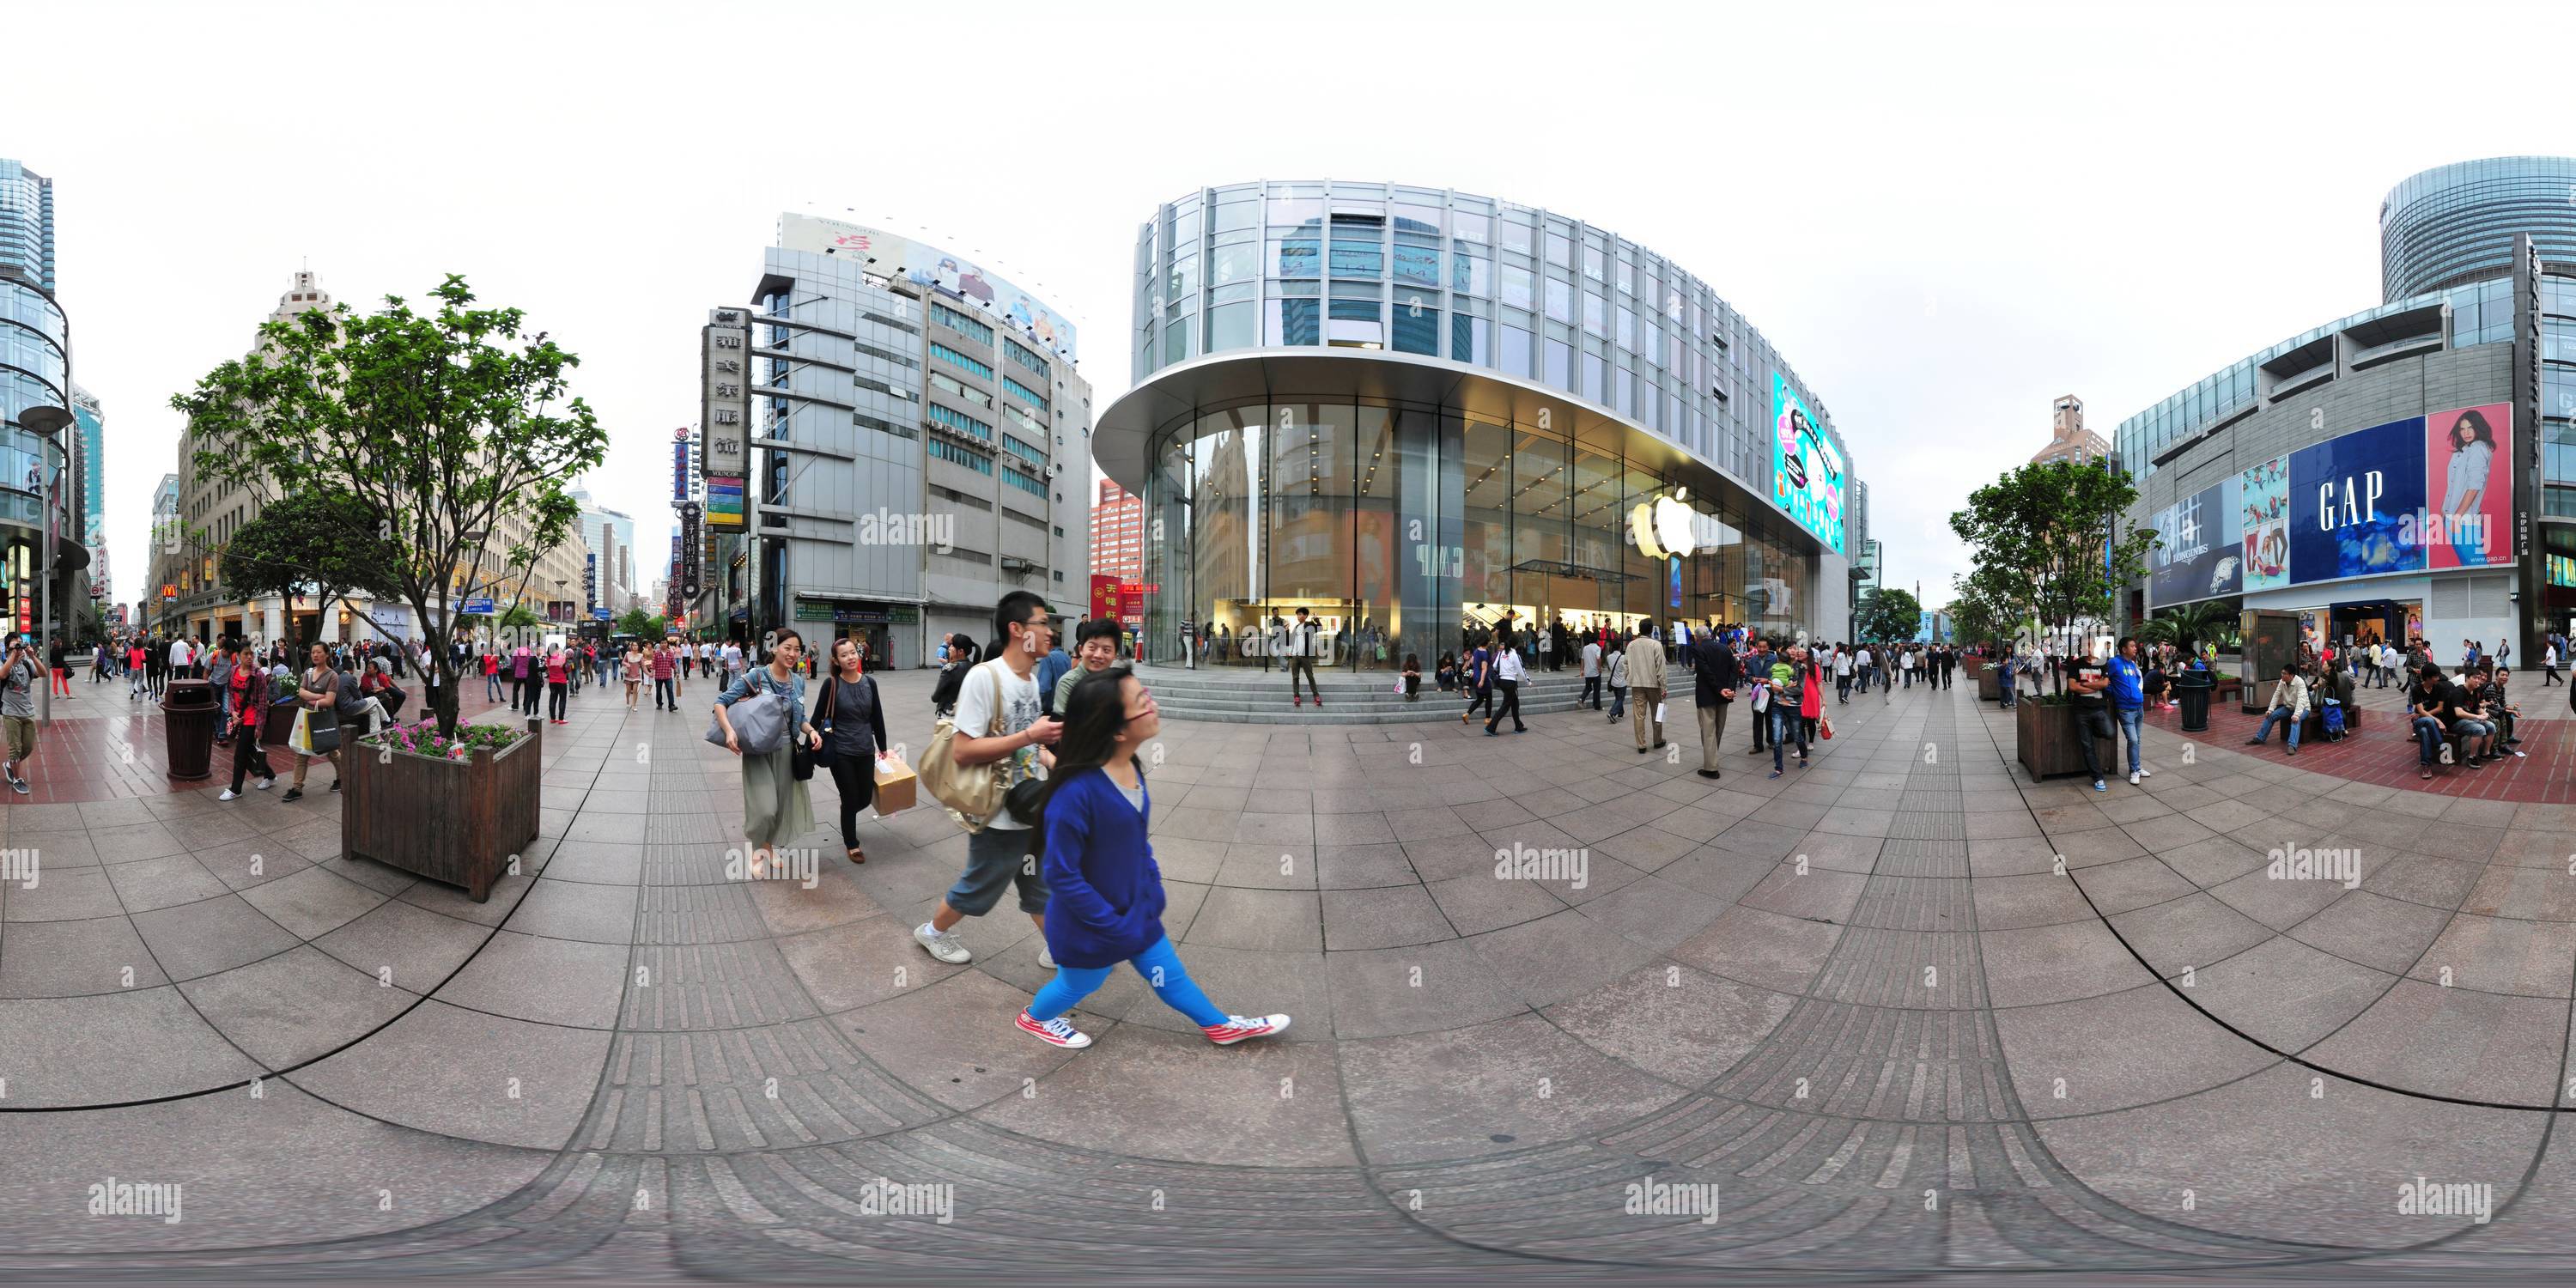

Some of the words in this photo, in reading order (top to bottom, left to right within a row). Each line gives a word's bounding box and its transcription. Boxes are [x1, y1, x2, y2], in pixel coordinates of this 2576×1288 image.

[716, 335, 741, 454] 雅戈尔服饰
[2320, 471, 2383, 531] GAP
[2172, 542, 2208, 563] LONGINES
[2470, 555, 2506, 563] www.gap.cn
